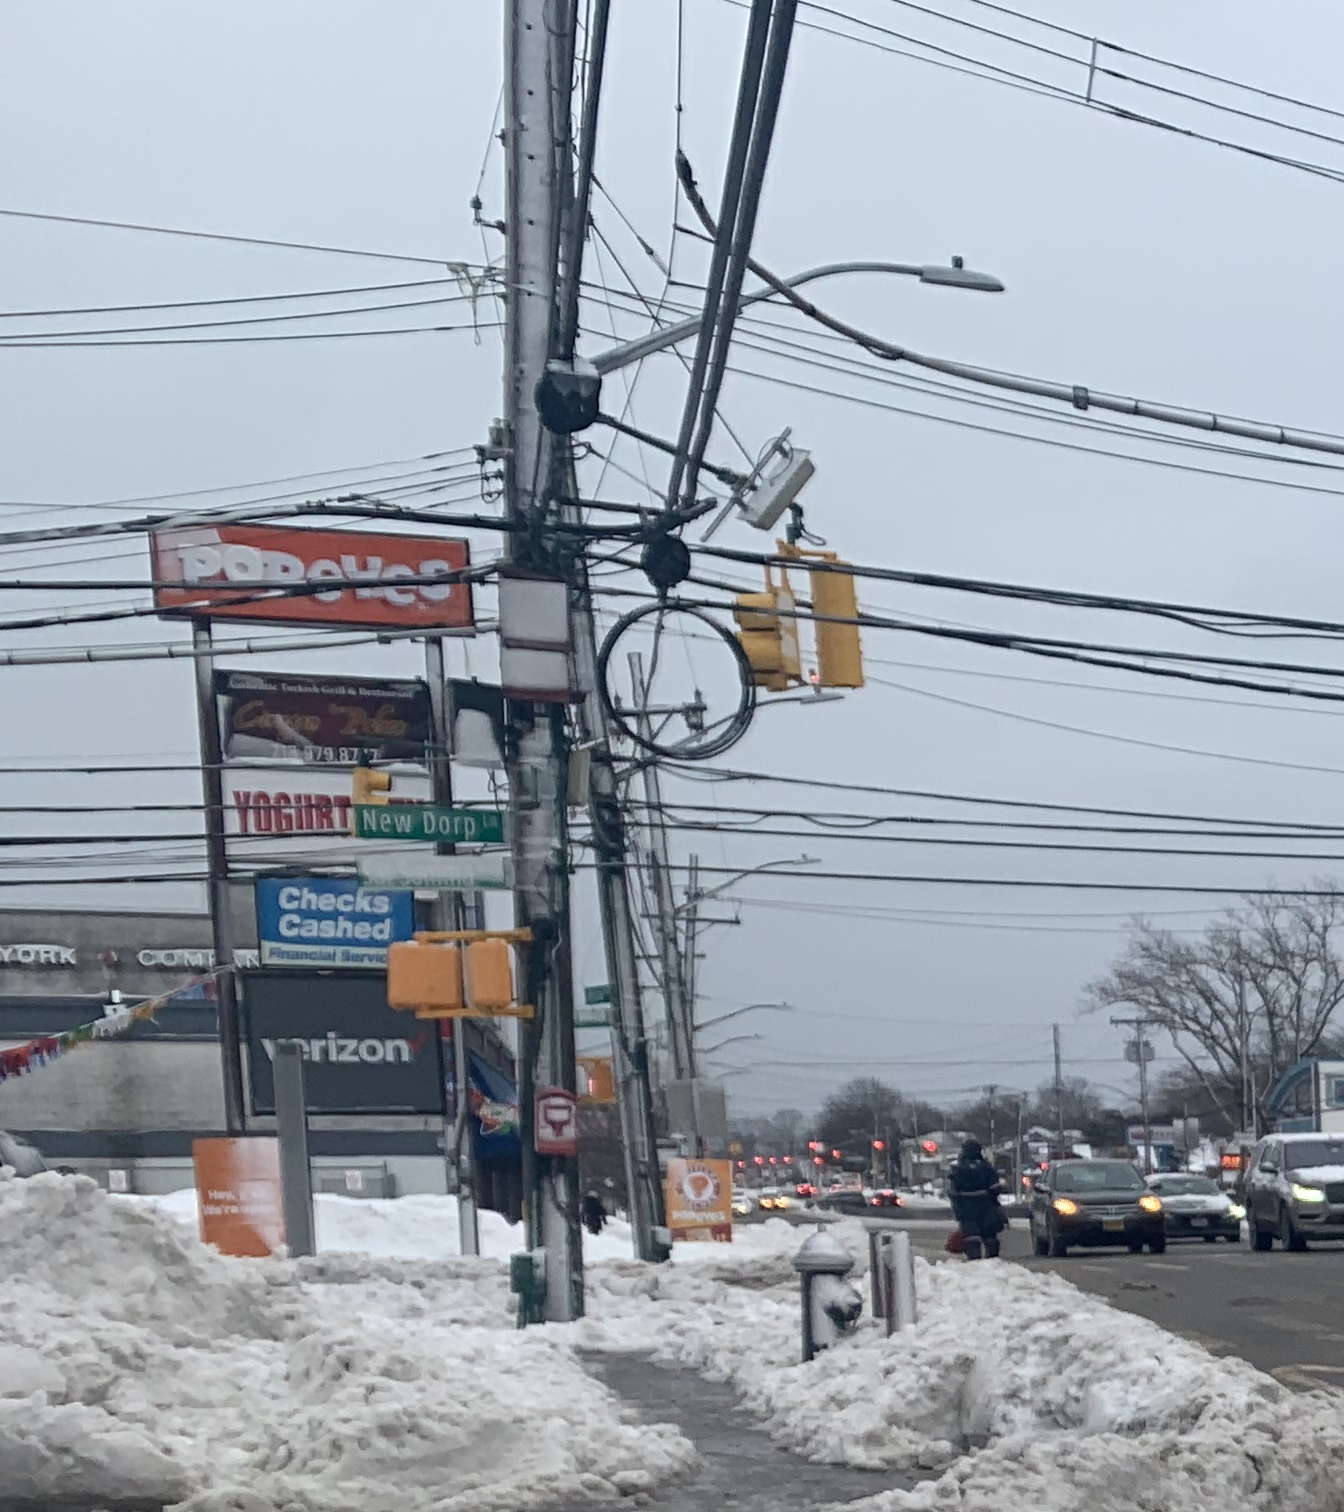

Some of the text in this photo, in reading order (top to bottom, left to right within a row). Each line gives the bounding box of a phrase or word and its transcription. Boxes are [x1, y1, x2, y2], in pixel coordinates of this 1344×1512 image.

[232, 790, 352, 834] YOGURT
[362, 809, 413, 834] New
[423, 811, 476, 841] Dorp
[278, 886, 392, 914] Checks
[278, 913, 392, 941] Cashed
[269, 947, 388, 964] Financial Servic
